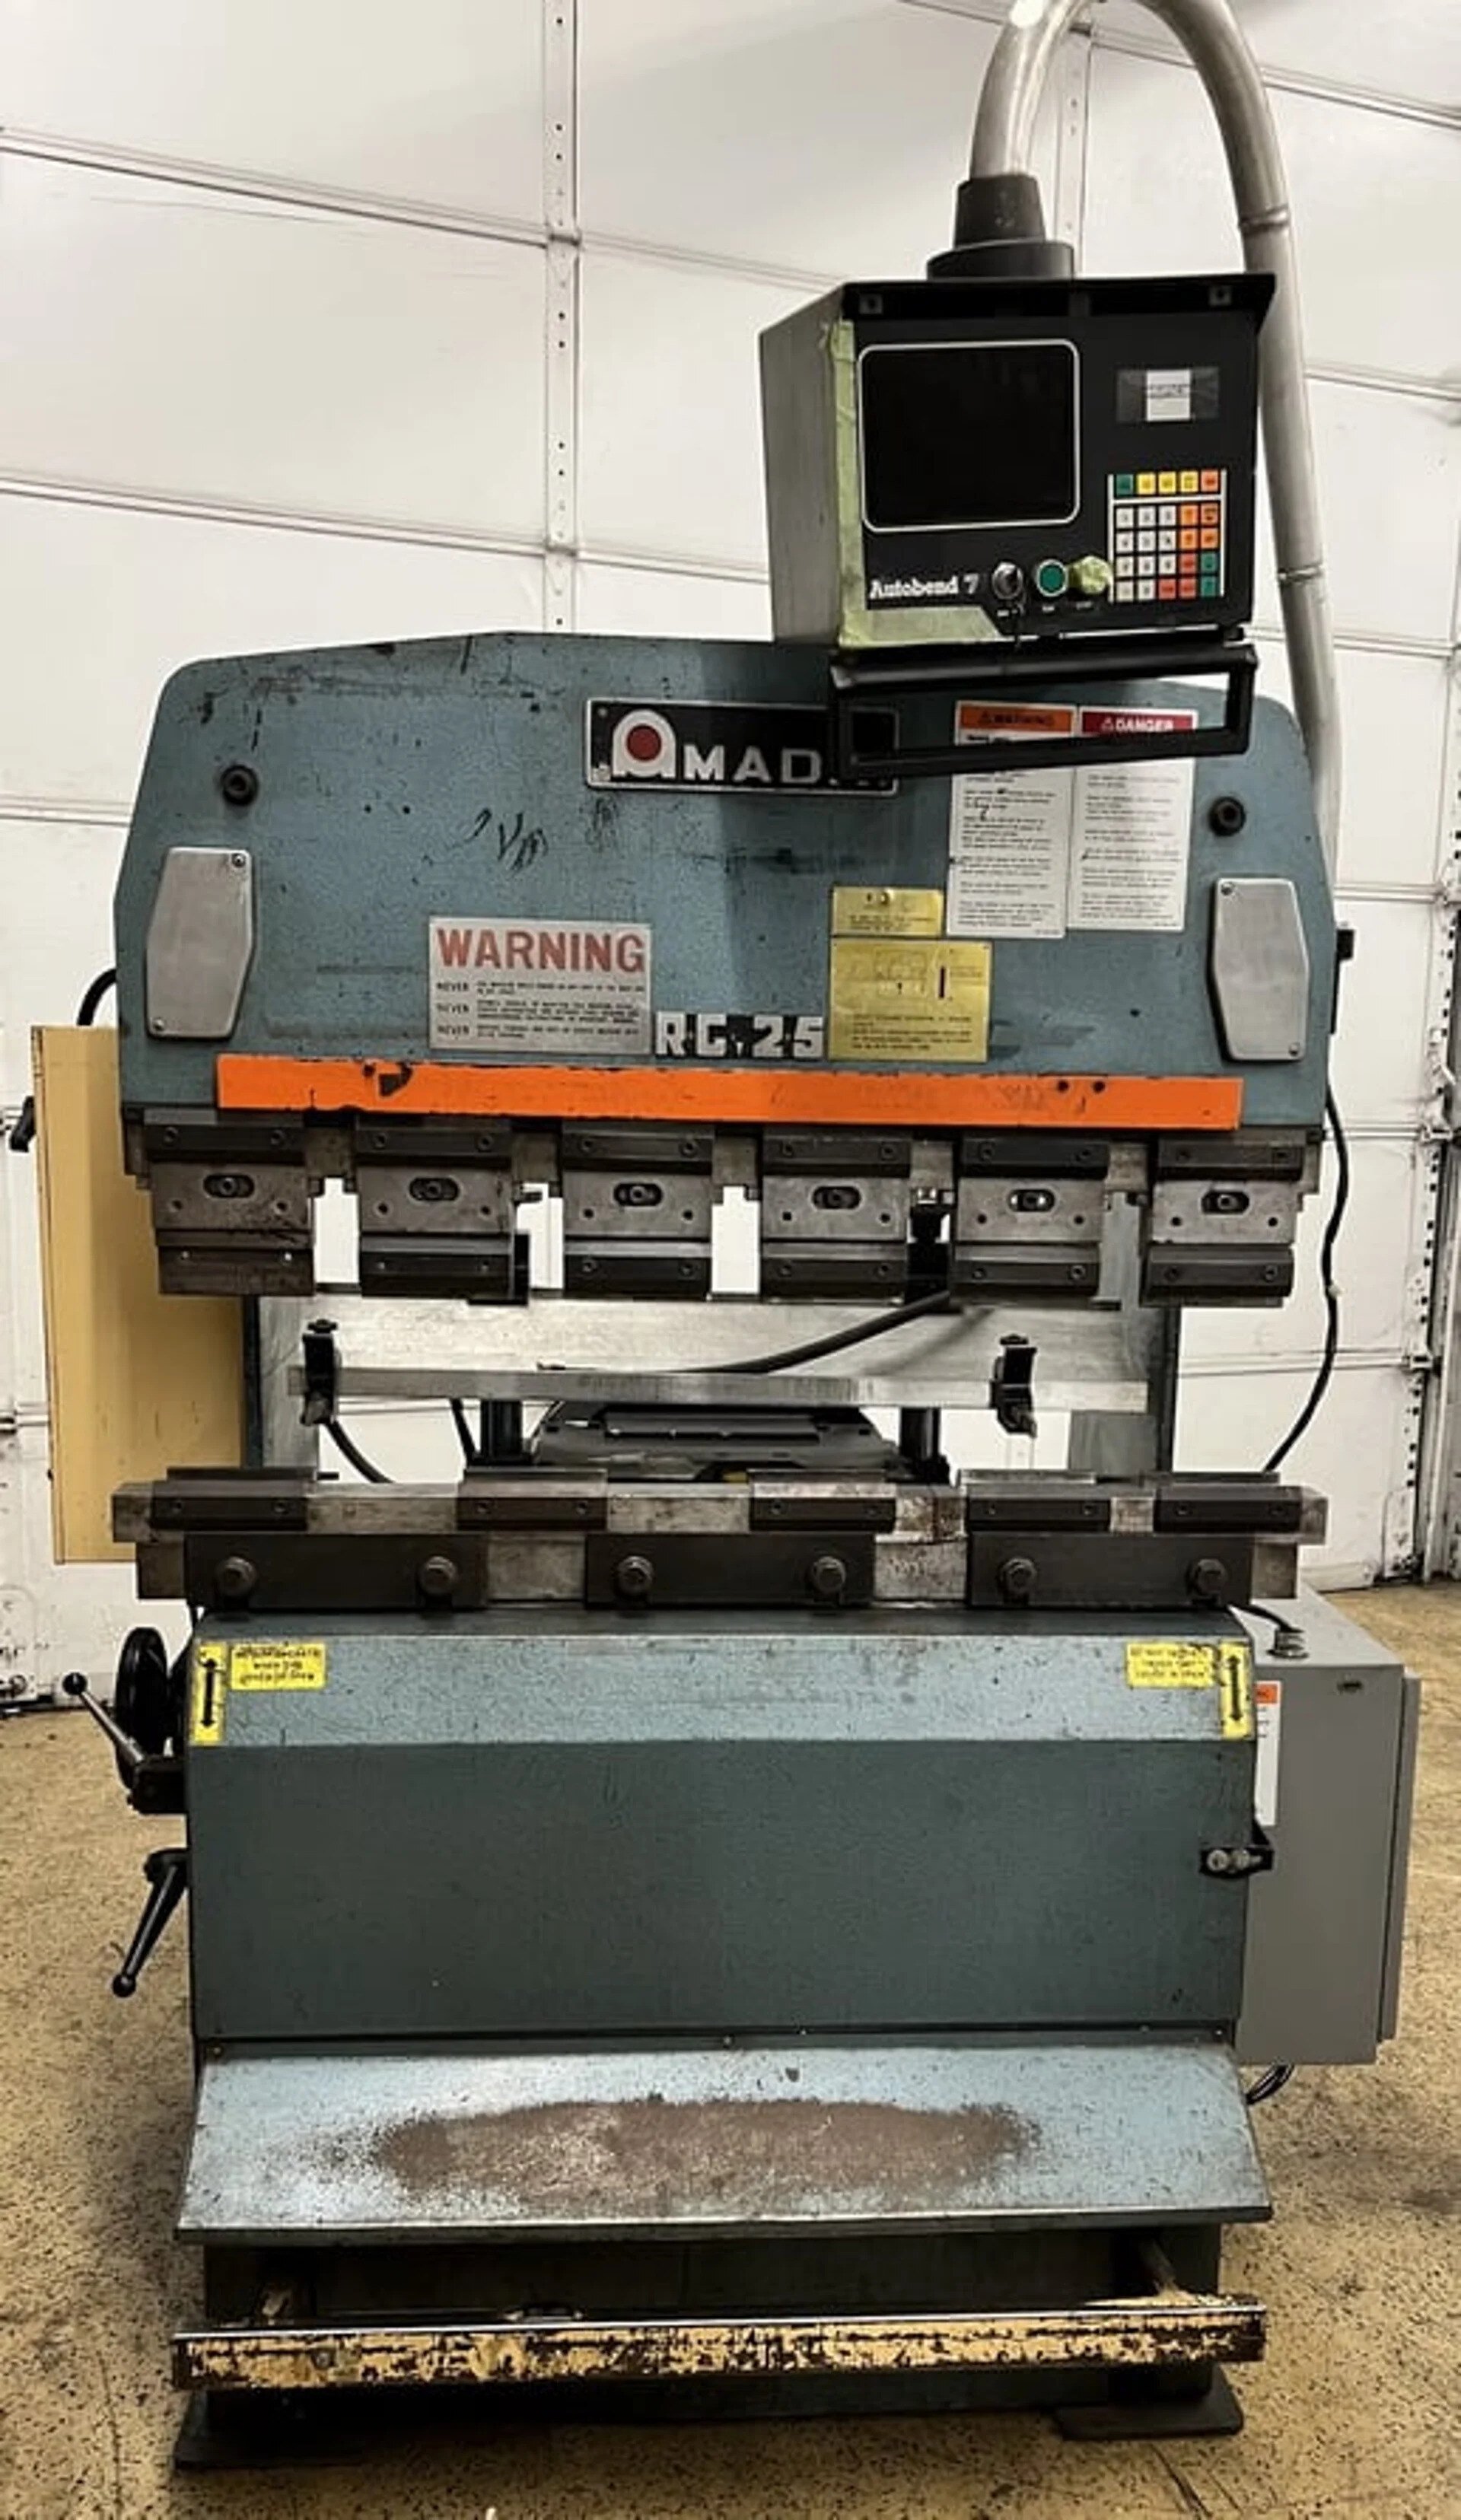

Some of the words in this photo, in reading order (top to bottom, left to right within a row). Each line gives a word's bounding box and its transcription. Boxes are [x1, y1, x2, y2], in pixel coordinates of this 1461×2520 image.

[869, 575, 959, 600] Autobend
[963, 572, 979, 594] 7
[1115, 718, 1174, 733] DANGER
[611, 708, 869, 784] AMAD
[436, 928, 645, 972] WARNING
